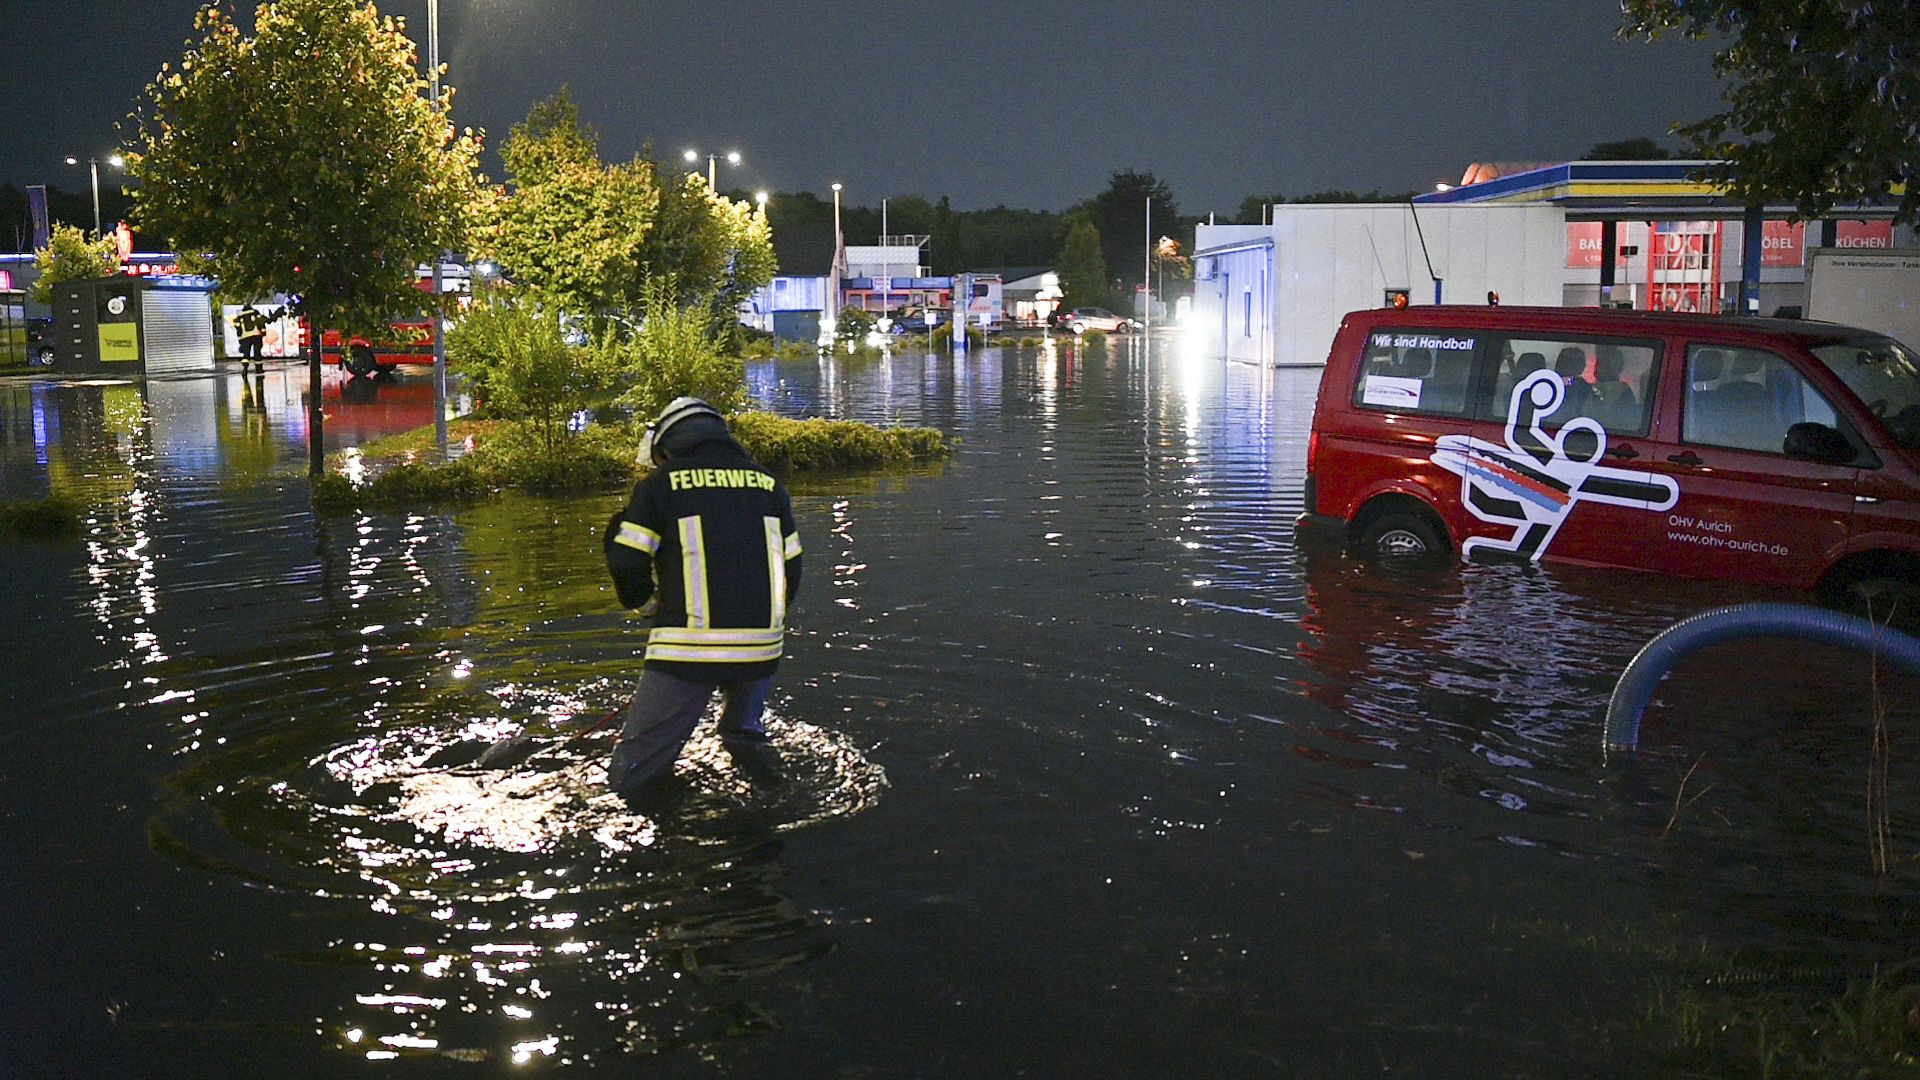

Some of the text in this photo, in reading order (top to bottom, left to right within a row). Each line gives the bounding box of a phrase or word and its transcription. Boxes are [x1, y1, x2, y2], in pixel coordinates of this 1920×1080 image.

[1761, 234, 1794, 249] ÖBEL
[1835, 235, 1886, 249] KÜCHEN
[1375, 335, 1474, 350] Wir sind Handball
[669, 469, 776, 492] FEUERWEHR
[1669, 515, 1732, 533] OHV Aurich
[1667, 531, 1788, 556] www.ohv-aurich.de
